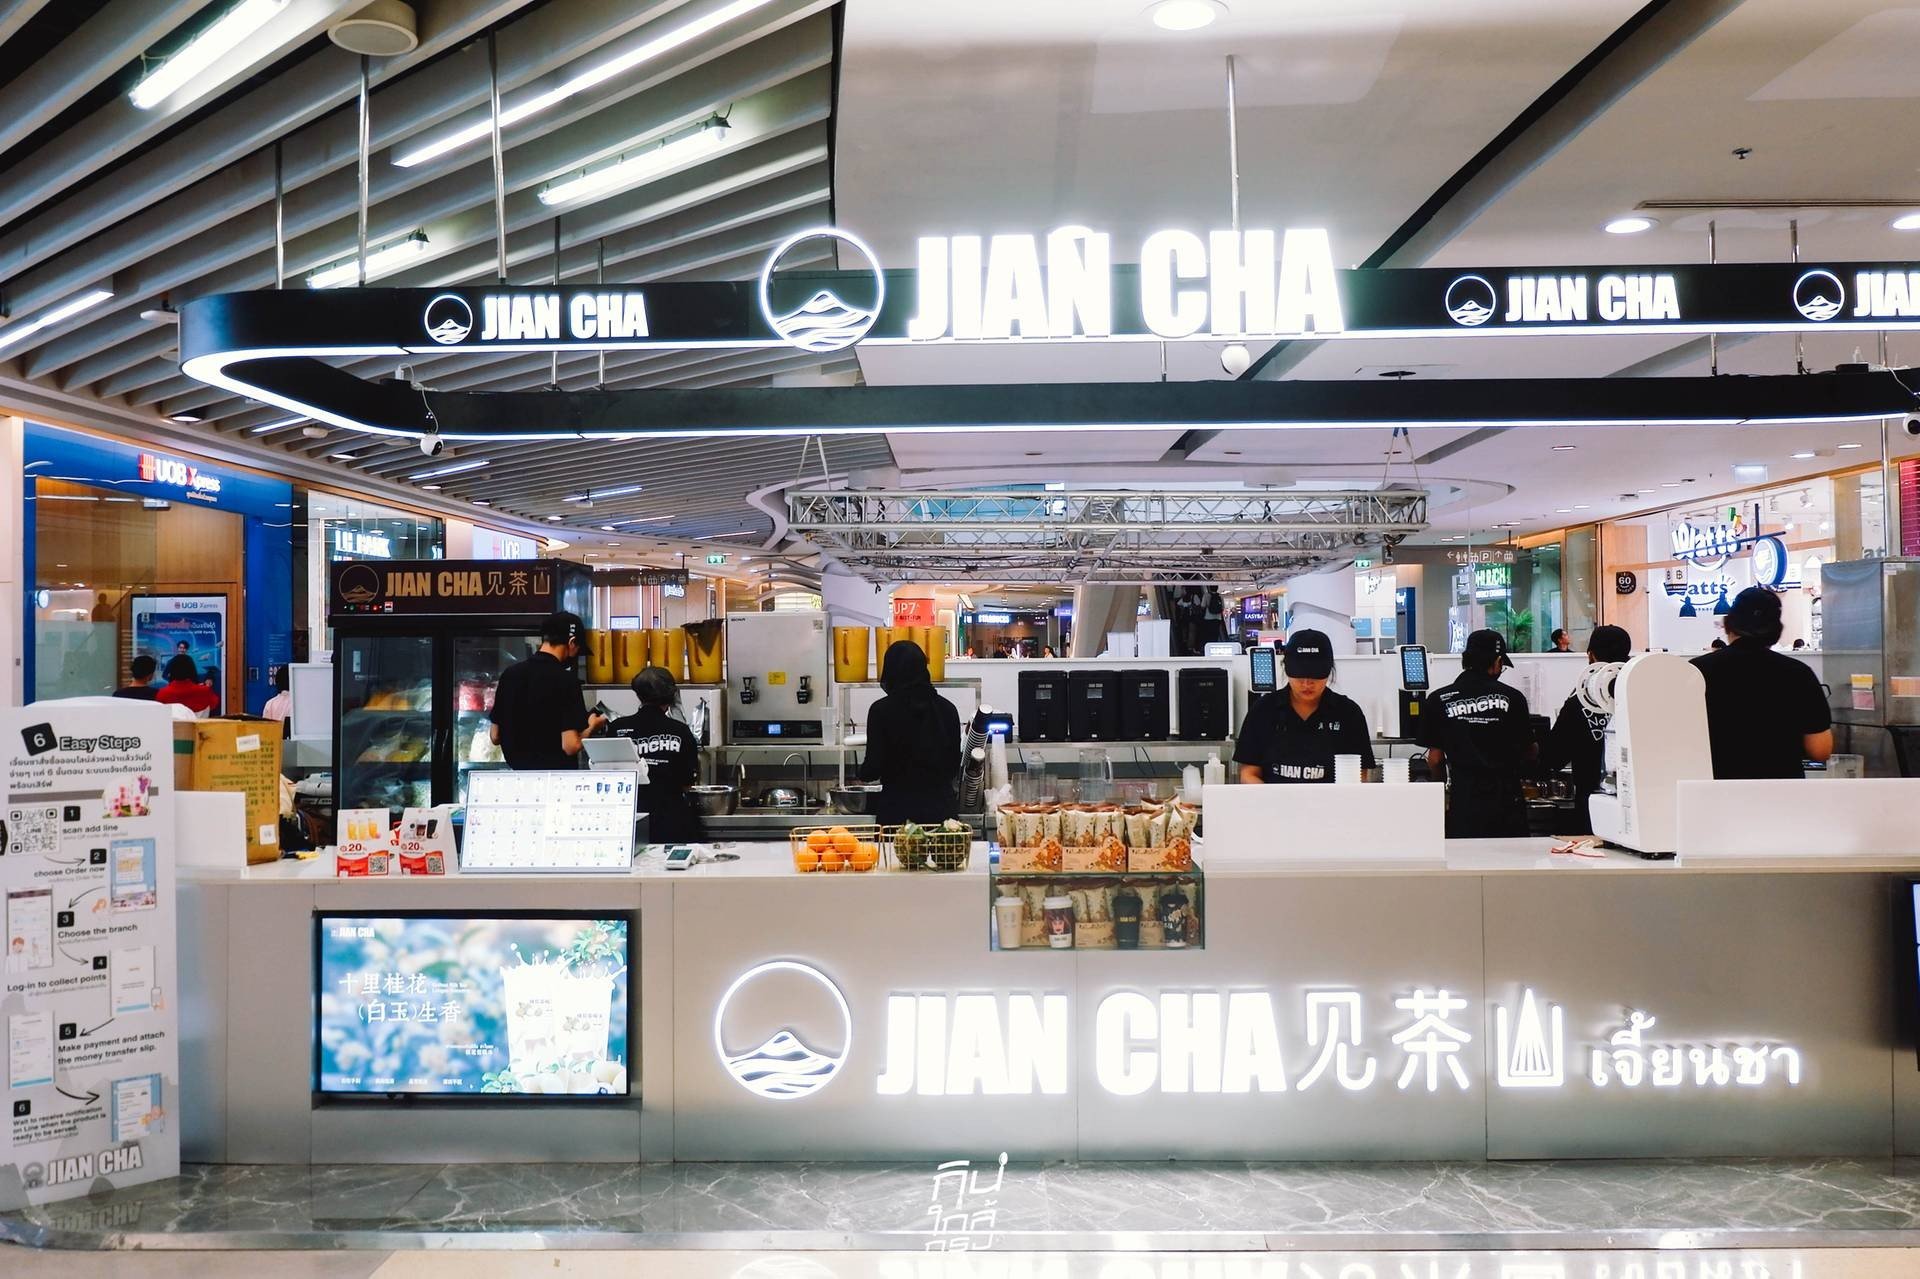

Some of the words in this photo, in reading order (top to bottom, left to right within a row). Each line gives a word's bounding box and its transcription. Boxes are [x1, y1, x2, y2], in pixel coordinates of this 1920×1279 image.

[909, 232, 1110, 340] JIAN
[1141, 229, 1344, 337] CHA
[1505, 276, 1587, 323] JIAN
[1598, 274, 1681, 320] CHA
[481, 294, 560, 341] JIAN
[569, 293, 650, 339] CHA
[156, 459, 187, 485] UOB
[1671, 522, 1741, 560] Watts
[385, 572, 432, 597] JIAN
[437, 571, 483, 597] CHA
[485, 571, 551, 597] 见茶山
[1618, 577, 1632, 585] 60
[33, 733, 46, 748] 6
[60, 737, 96, 752] Easy
[100, 735, 141, 751] Steps
[62, 826, 82, 834] scan
[34, 869, 63, 878] choose
[65, 867, 87, 876] Order
[58, 929, 91, 939] Choose
[93, 926, 107, 936] the
[109, 924, 138, 934] branch
[7, 981, 36, 993] Log-in
[38, 980, 47, 988] to
[49, 976, 78, 987] collect
[80, 972, 107, 984] points
[338, 972, 427, 995] 十里桂花
[57, 1043, 81, 1053] Make
[84, 1038, 120, 1051] payment
[122, 1035, 138, 1044] and
[140, 1031, 165, 1041] attach
[876, 991, 1068, 1096] JIAN
[1096, 988, 1287, 1096] CHA
[1297, 986, 1563, 1091] 见茶山
[1592, 1011, 1801, 1088] เจี้ยนชา
[57, 1056, 72, 1065] the
[74, 1053, 103, 1063] money
[105, 1047, 137, 1058] transfer
[139, 1044, 157, 1054] slip.
[39, 1113, 64, 1122] receive
[65, 1106, 103, 1117] notification
[41, 1121, 59, 1129] when
[73, 1113, 99, 1124] product
[12, 1134, 33, 1143] ready
[48, 1154, 93, 1186] JIAN
[99, 1146, 142, 1175] CHA
